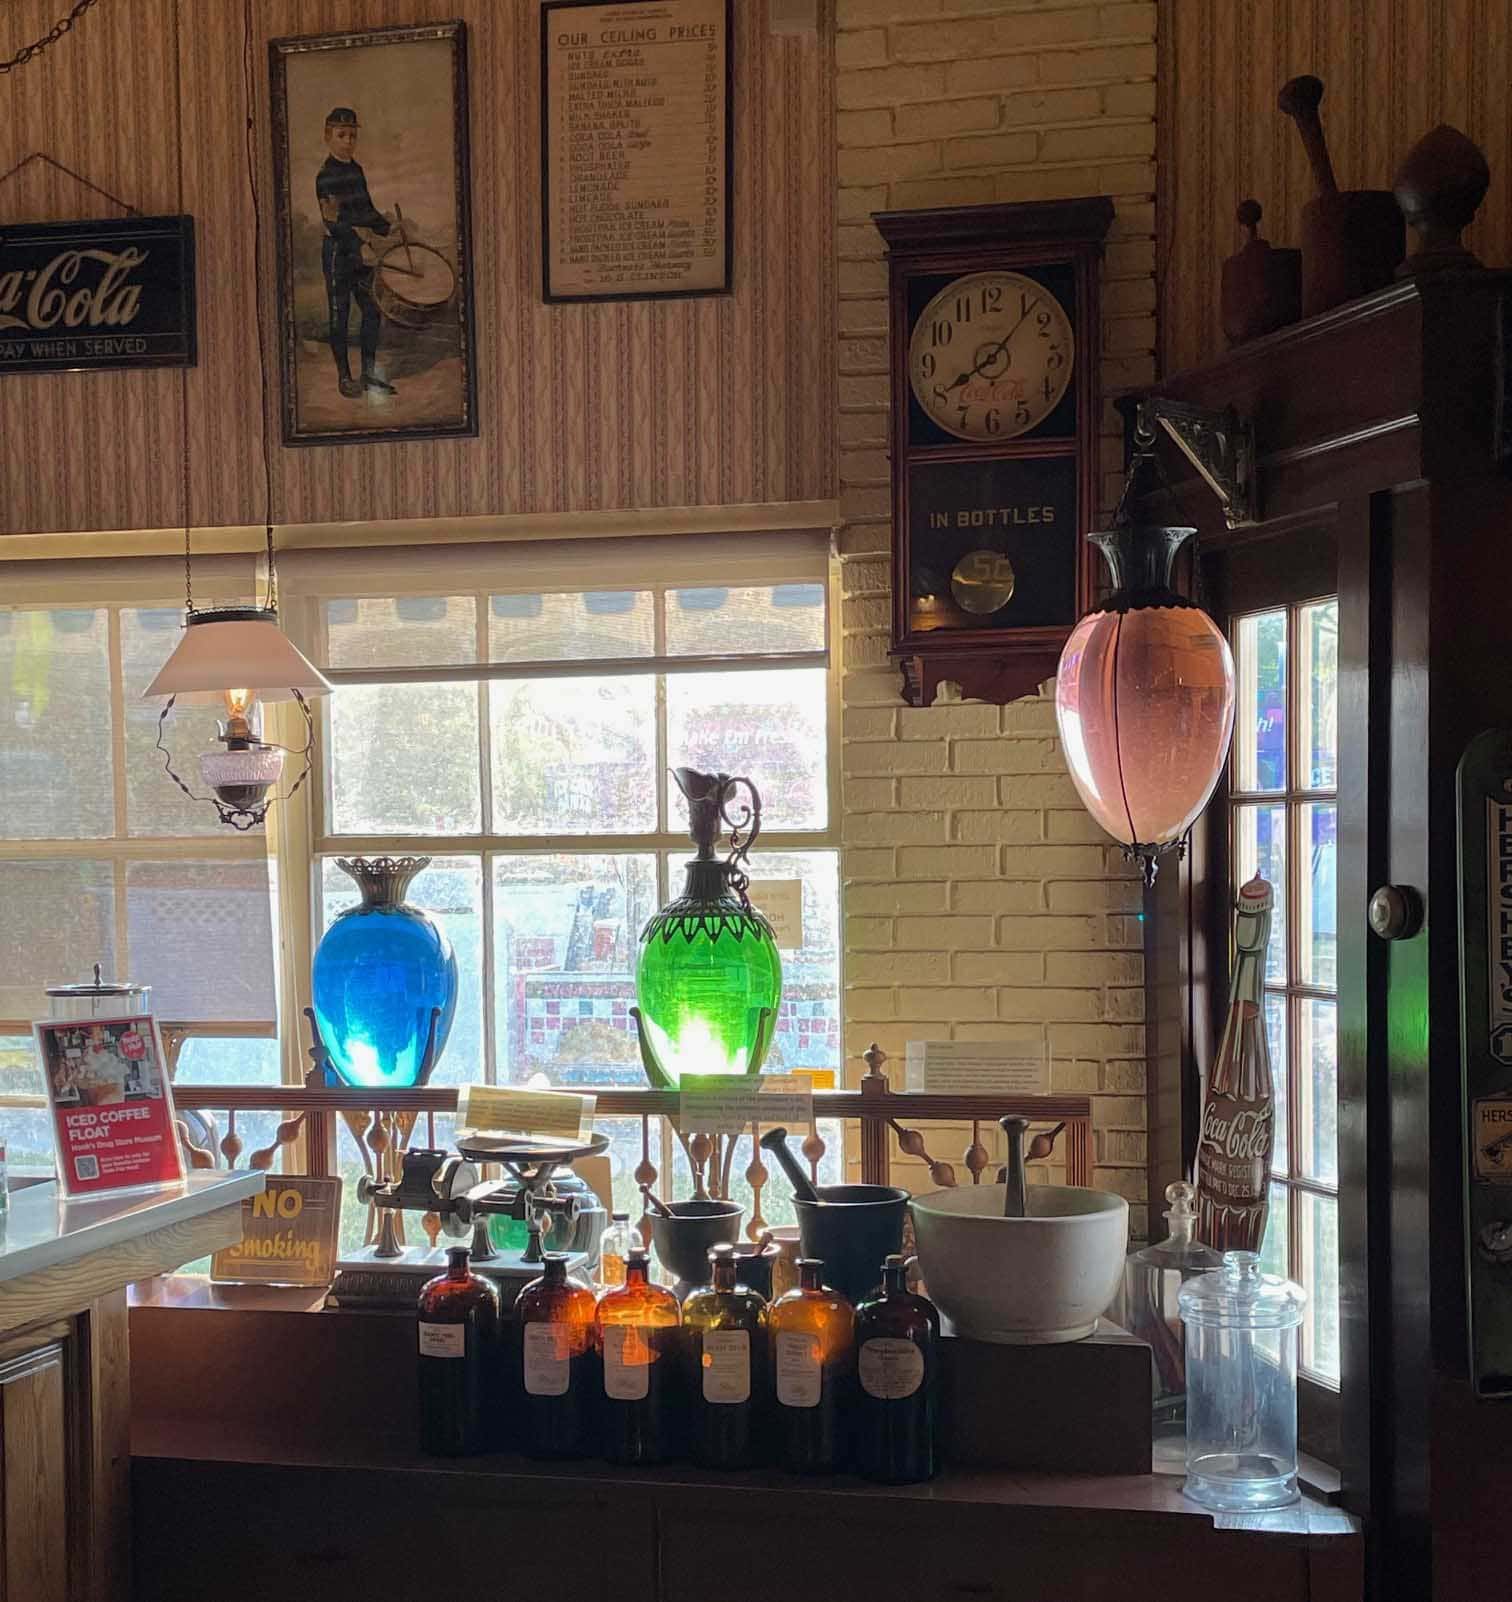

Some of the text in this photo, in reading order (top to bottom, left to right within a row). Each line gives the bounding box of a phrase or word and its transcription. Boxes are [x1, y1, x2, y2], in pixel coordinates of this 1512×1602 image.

[557, 24, 716, 46] OUR CEILING PRICES
[955, 296, 971, 323] 11
[980, 287, 1003, 314] 12
[931, 320, 952, 347] 10
[1036, 312, 1051, 338] 2
[30, 340, 76, 358] WHEN
[85, 338, 147, 355] SERVED
[921, 353, 936, 378] 9
[932, 383, 949, 409] 8
[1040, 376, 1055, 402] 4
[956, 405, 970, 430] 7
[984, 408, 1001, 434] 6
[1015, 400, 1030, 425] 5
[929, 506, 1056, 529] IN BOTTLES
[66, 1107, 151, 1129] ICED COFFEE
[69, 1125, 111, 1141] FLOAT
[1203, 1102, 1273, 1160] Coca-Cola
[96, 1140, 115, 1150] Drug
[115, 1138, 133, 1147] Store
[252, 1189, 303, 1219] NO
